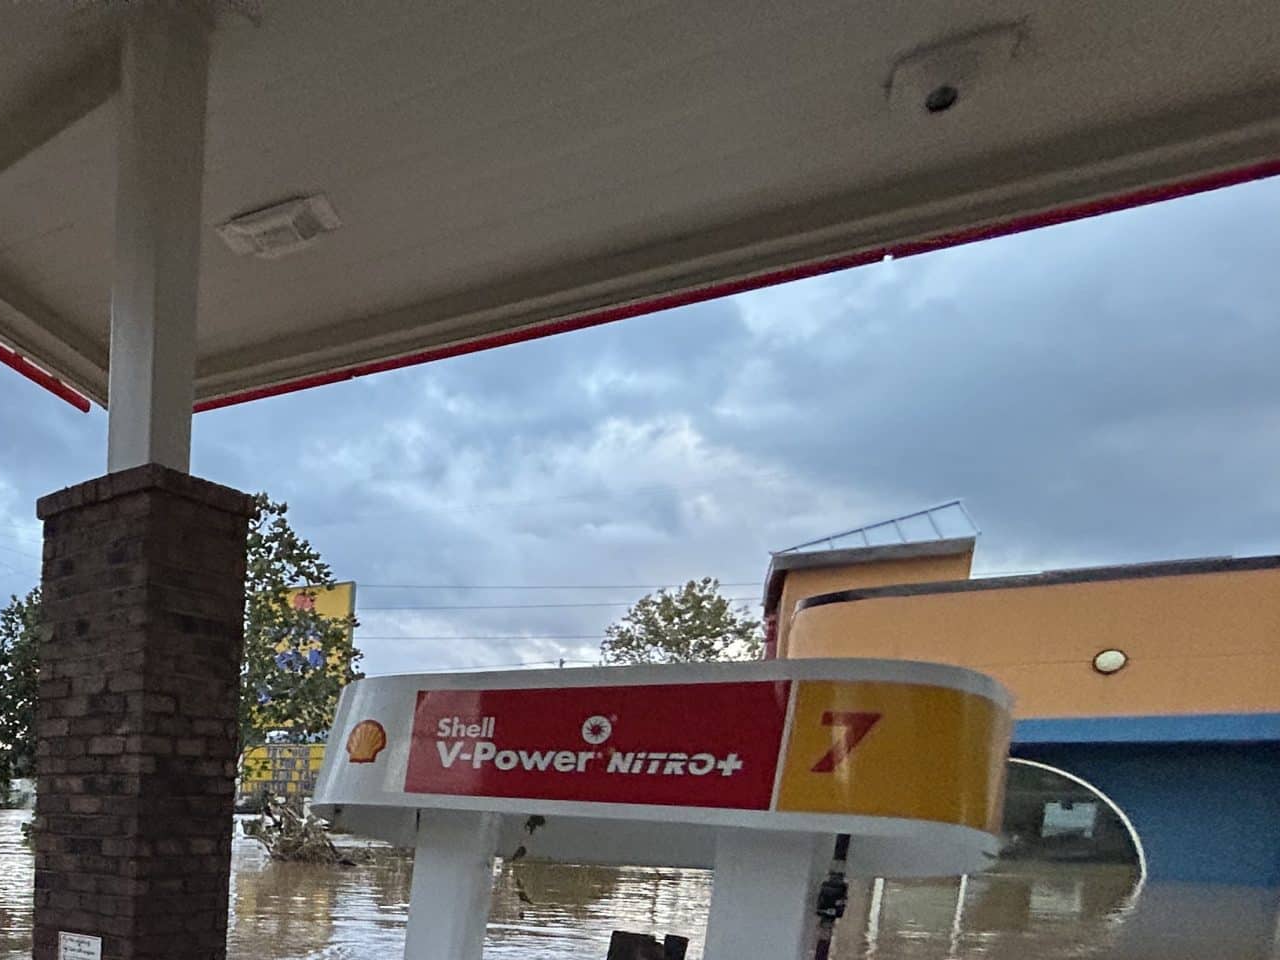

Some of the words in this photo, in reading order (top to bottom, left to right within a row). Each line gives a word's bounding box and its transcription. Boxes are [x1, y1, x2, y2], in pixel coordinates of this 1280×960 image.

[437, 716, 496, 738] Shell
[810, 711, 883, 773] 7
[436, 741, 595, 772] V-Power
